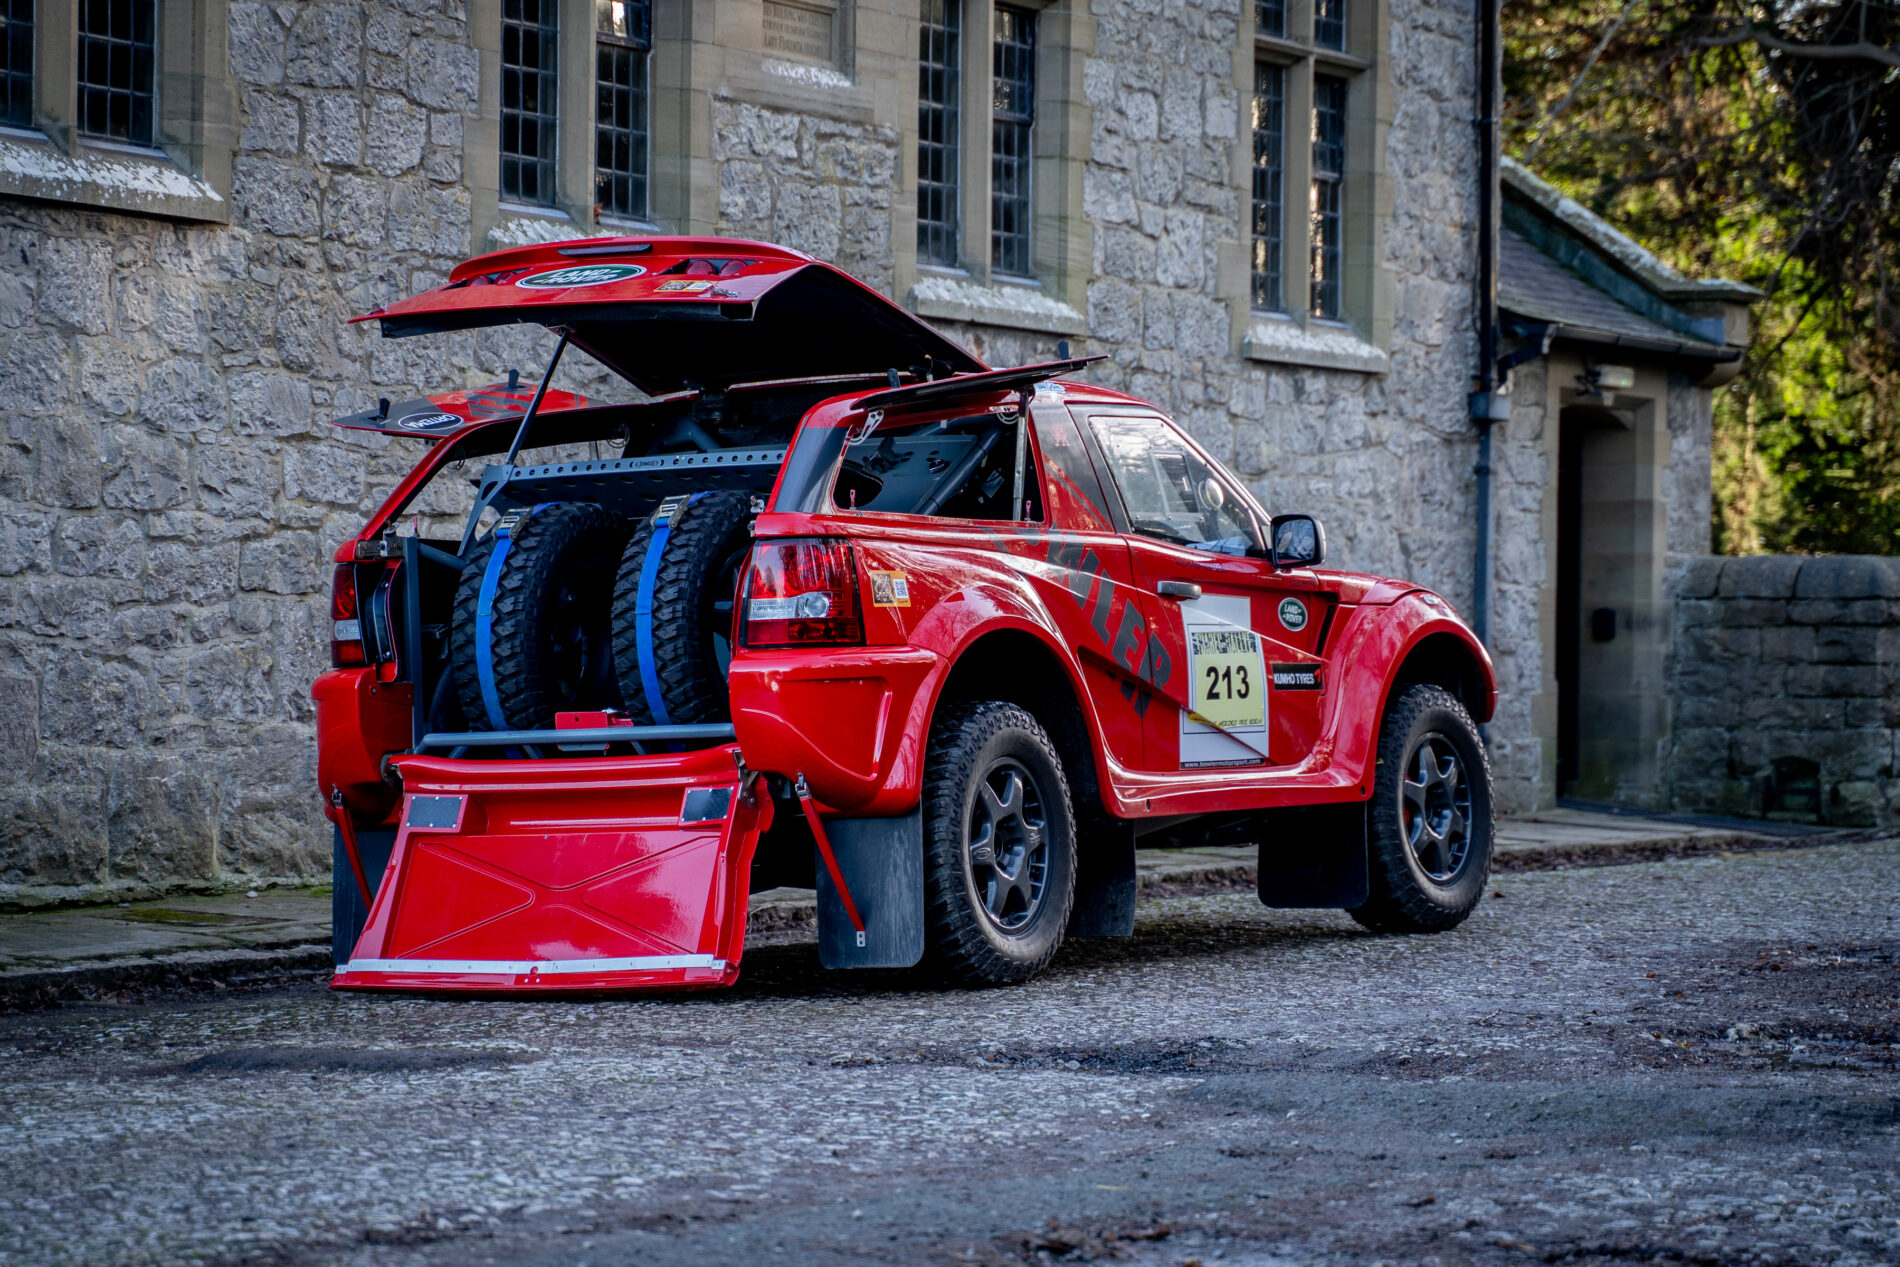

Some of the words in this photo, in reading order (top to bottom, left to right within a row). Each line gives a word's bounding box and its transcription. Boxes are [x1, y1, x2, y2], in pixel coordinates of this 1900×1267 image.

[1206, 665, 1250, 700] 213
[1273, 672, 1296, 684] KUMHO
[1295, 672, 1315, 685] TYRES
